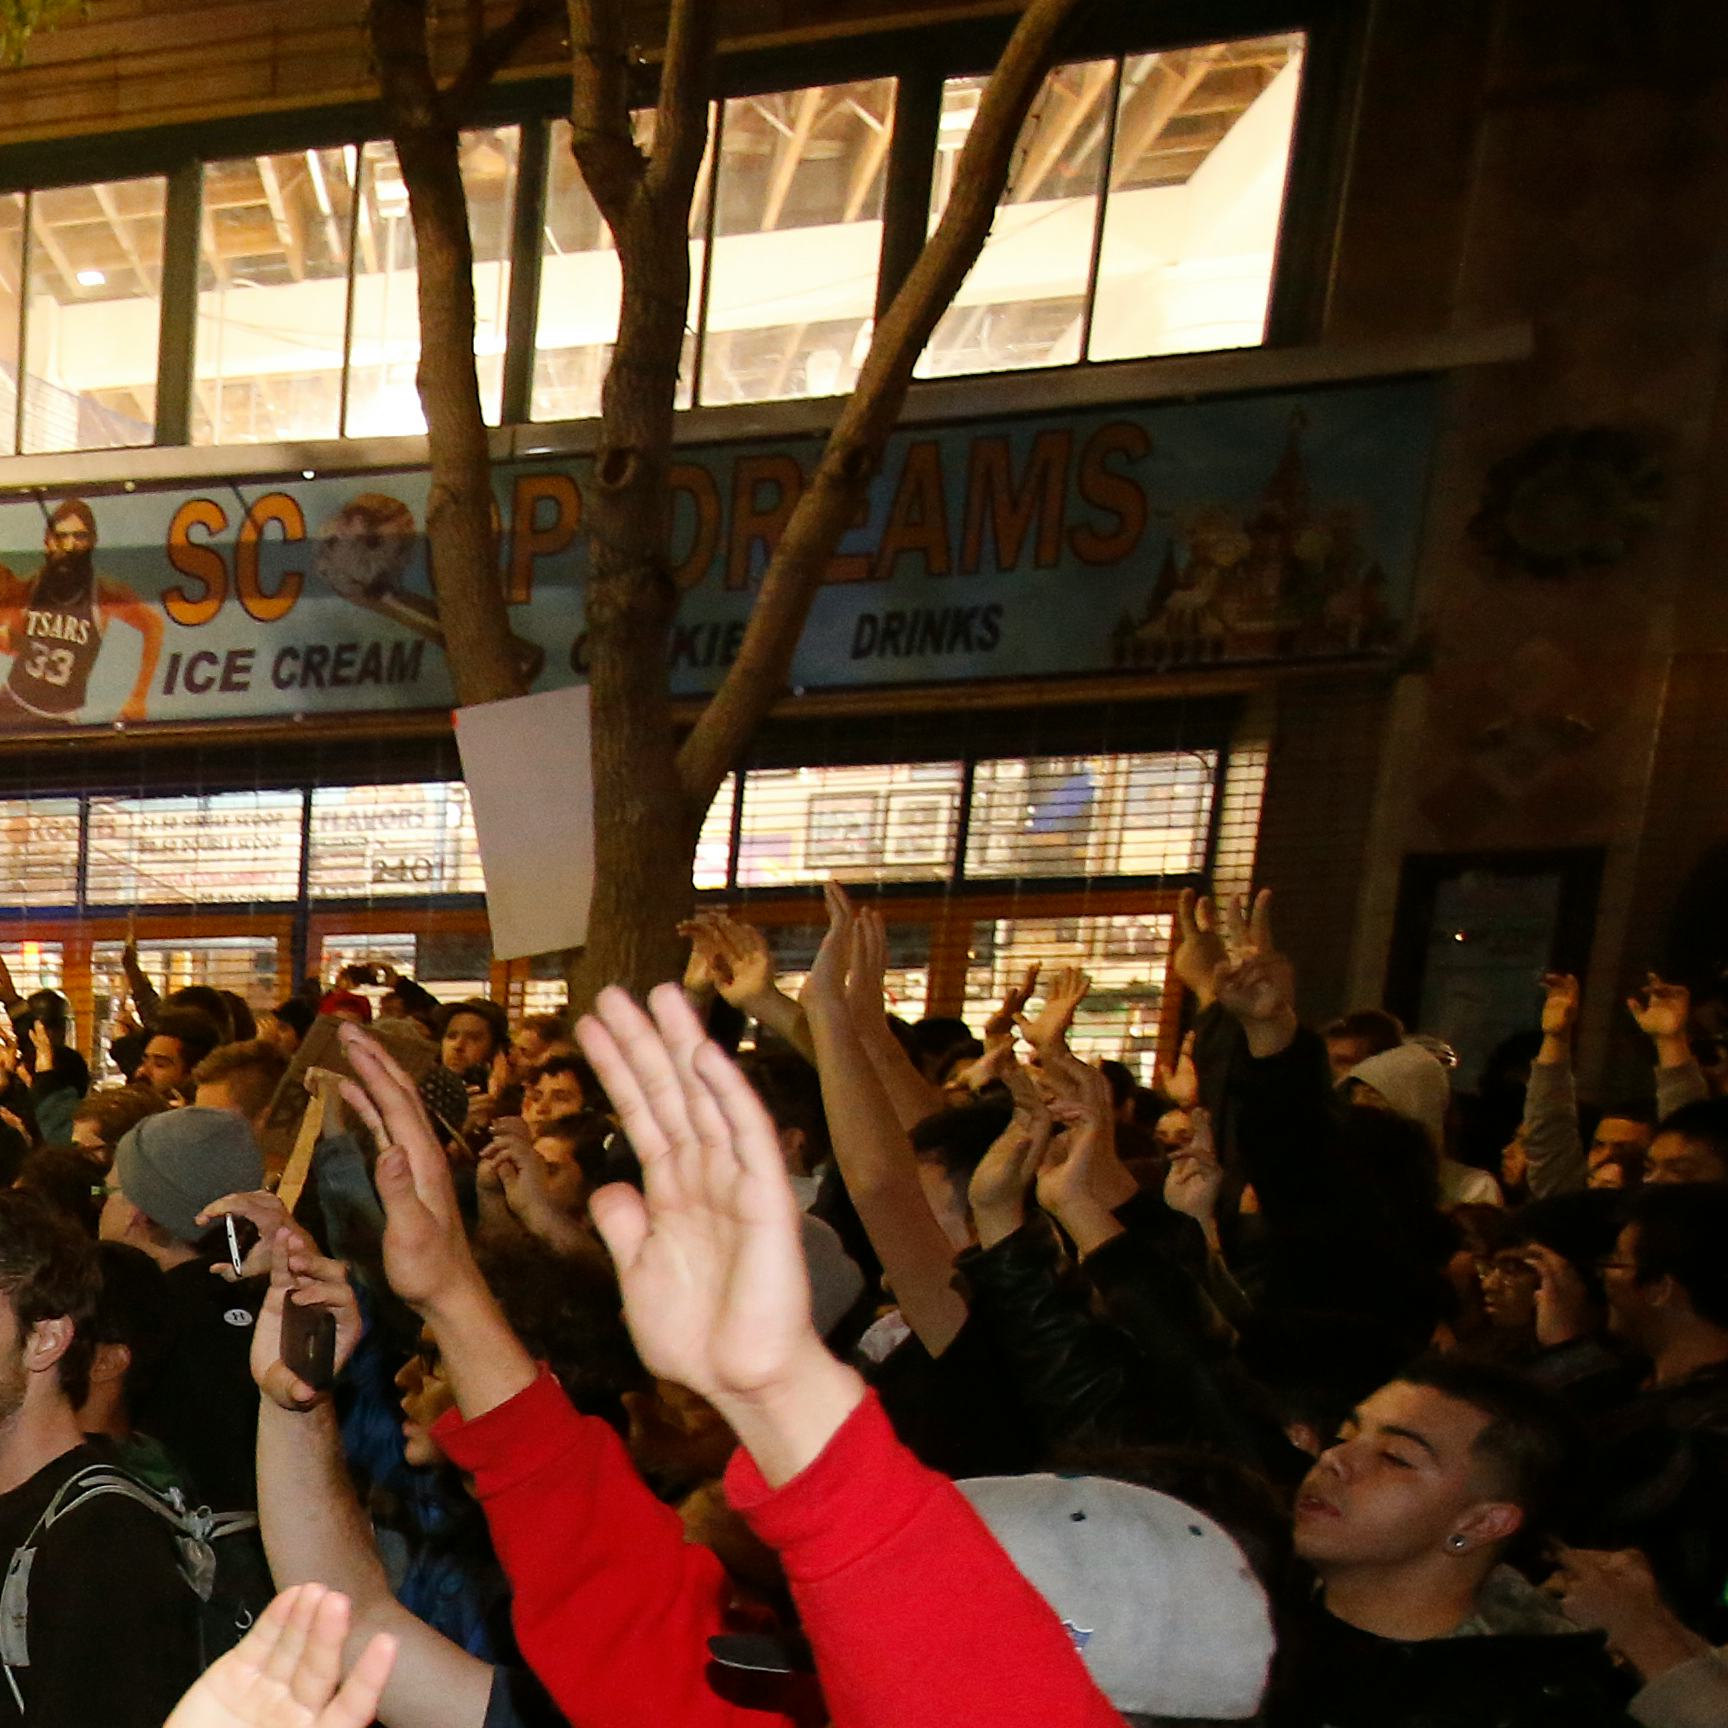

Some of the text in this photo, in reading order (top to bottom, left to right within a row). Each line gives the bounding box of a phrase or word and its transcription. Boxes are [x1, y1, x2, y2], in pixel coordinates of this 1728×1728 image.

[25, 610, 90, 645] TSARS
[162, 648, 256, 697] ICE
[270, 639, 425, 691] CREAM
[850, 603, 1004, 661] DRINKS
[25, 642, 76, 687] 33
